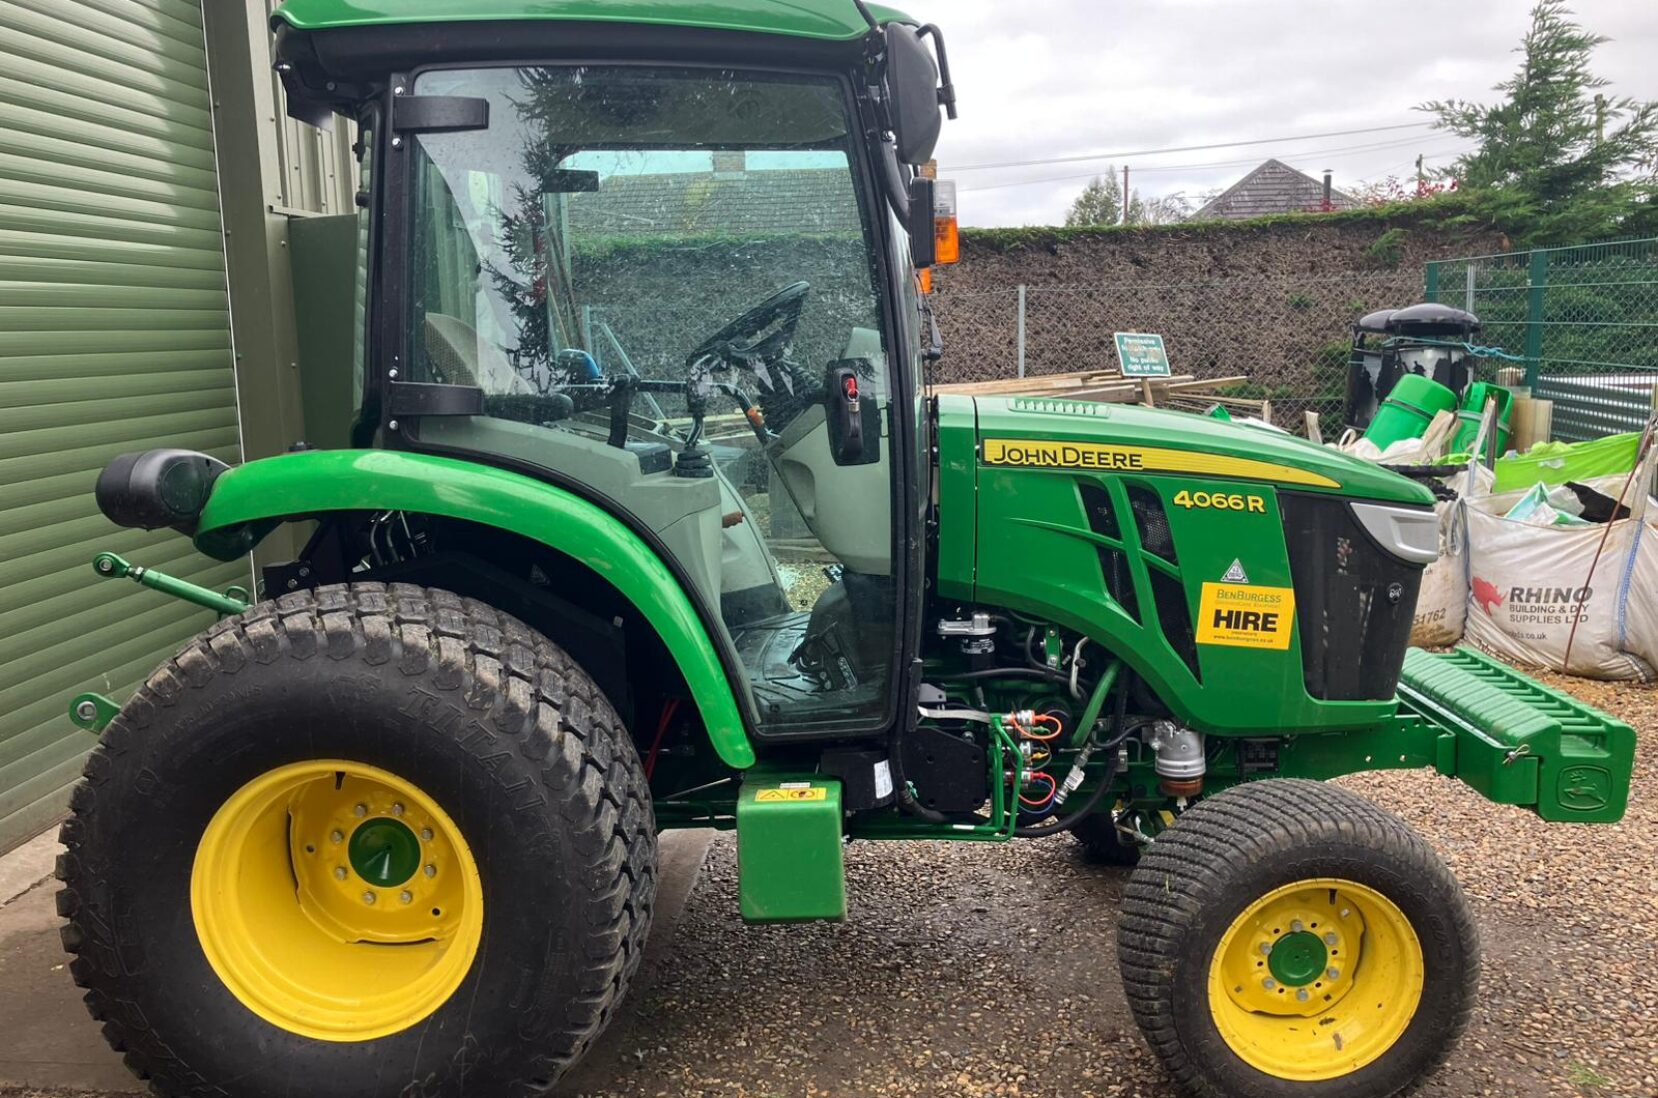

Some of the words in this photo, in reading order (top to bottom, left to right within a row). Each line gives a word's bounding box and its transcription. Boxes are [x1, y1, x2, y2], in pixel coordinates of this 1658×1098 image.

[994, 445, 1057, 464] JOHN
[1062, 446, 1143, 468] DEERE
[1509, 586, 1594, 604] RHINO
[1509, 604, 1556, 614] BUILDING
[1558, 605, 1567, 614] &
[1569, 604, 1590, 614] DY
[1213, 609, 1279, 633] HIRE
[1509, 614, 1562, 624] SUPPLIES
